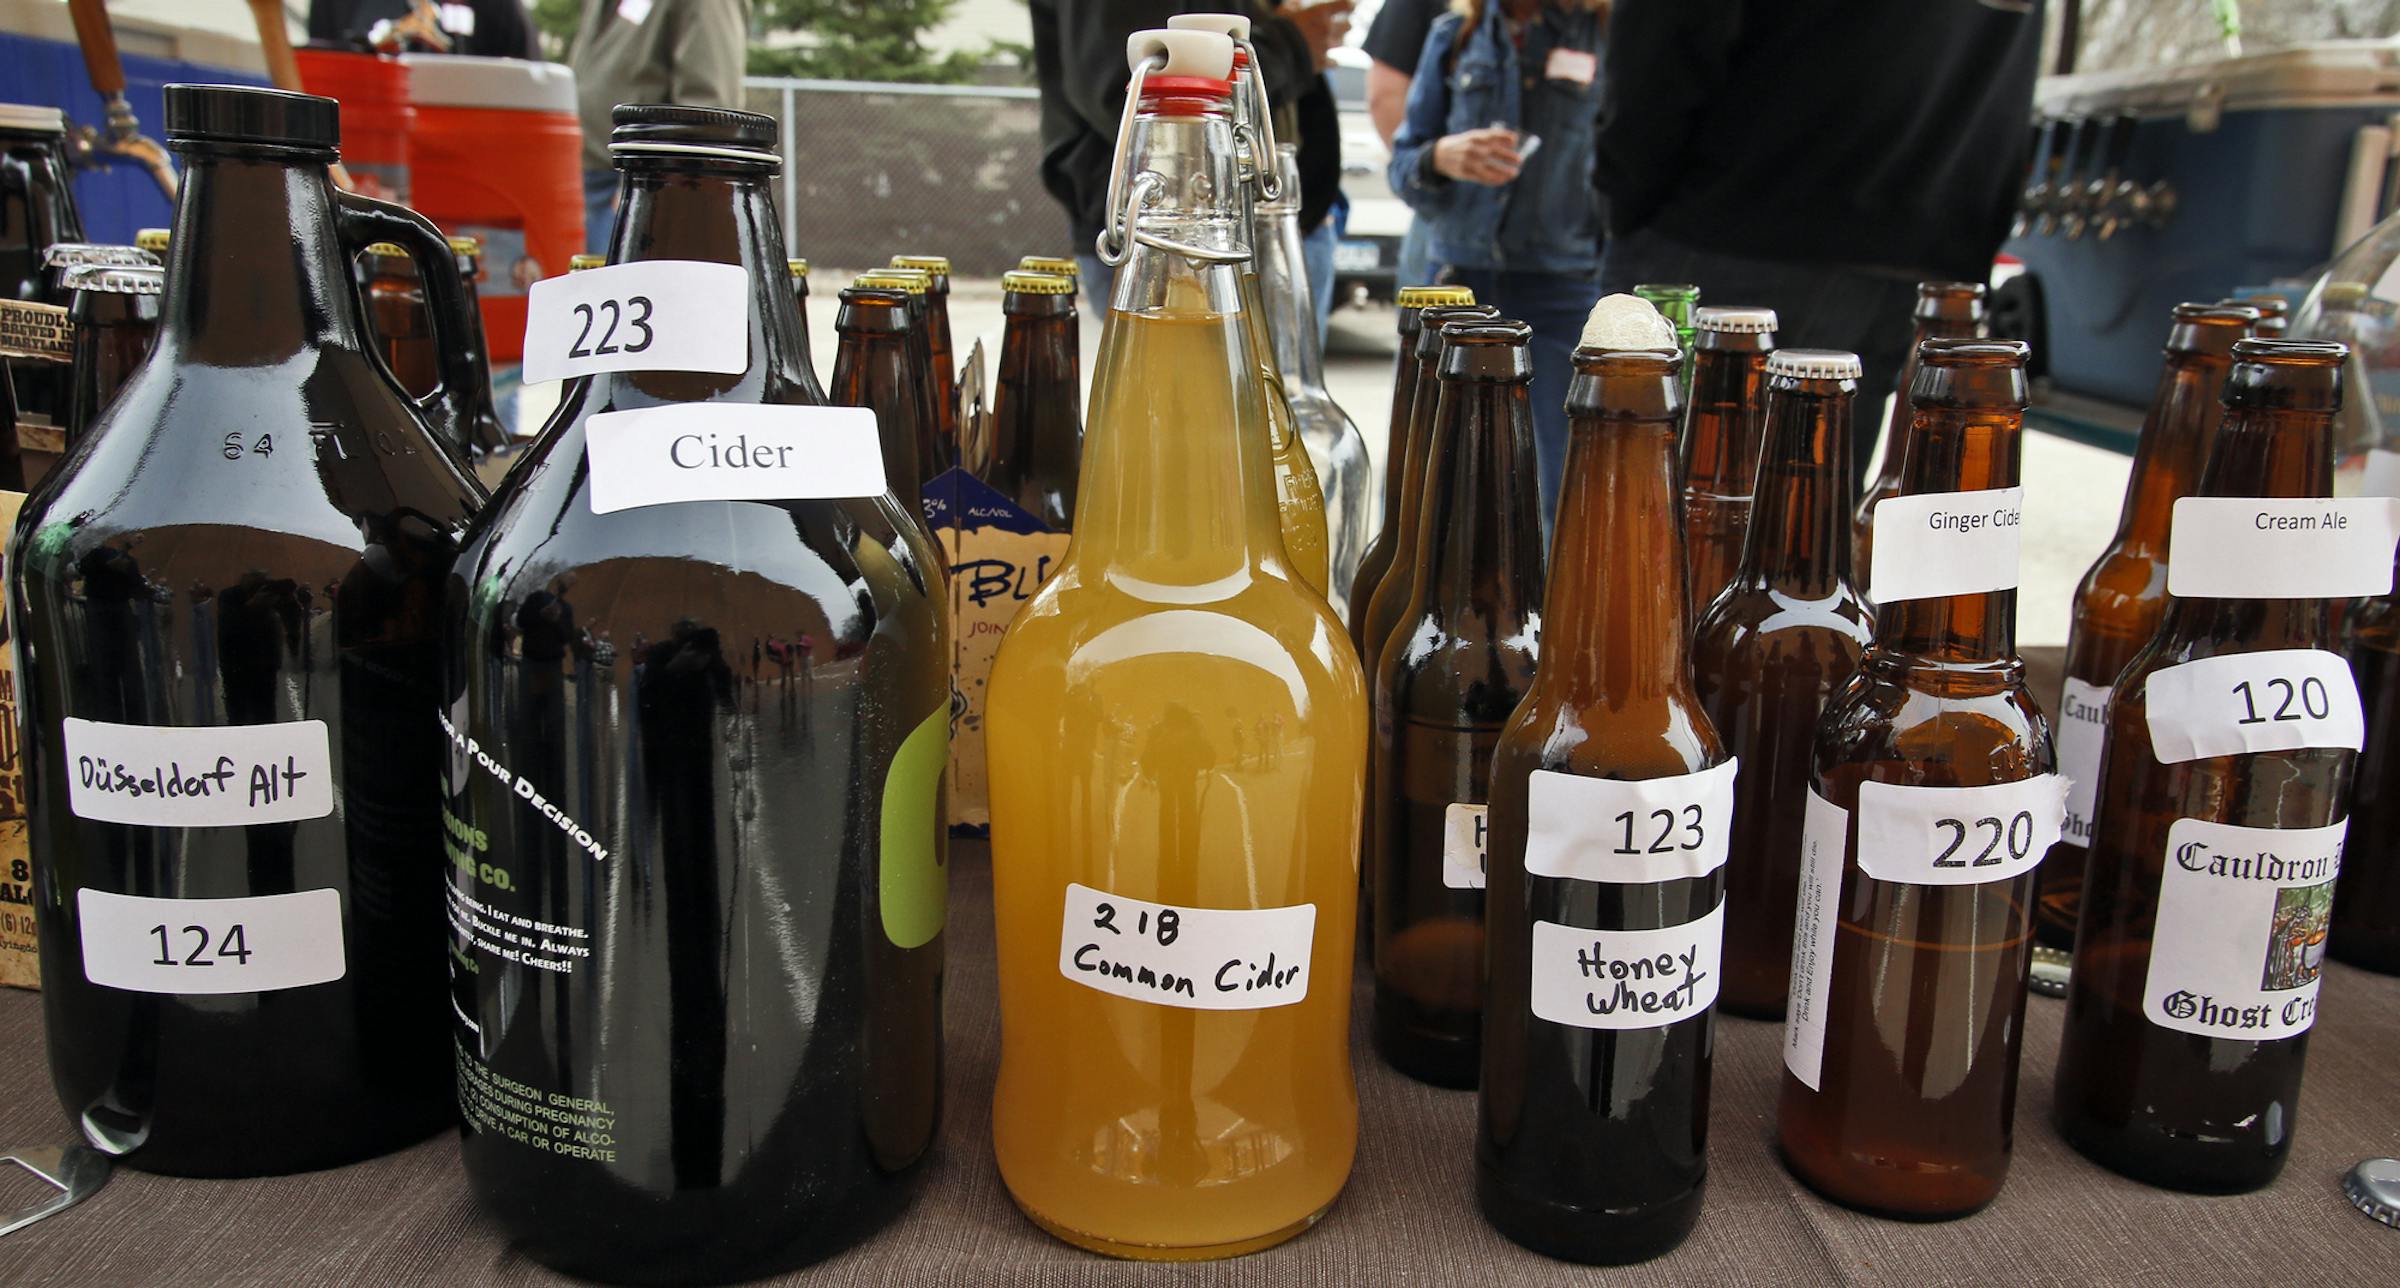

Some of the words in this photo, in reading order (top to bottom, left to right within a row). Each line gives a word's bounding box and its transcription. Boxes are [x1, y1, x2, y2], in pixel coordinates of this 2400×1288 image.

[569, 296, 653, 359] 223
[224, 431, 274, 460] 64
[670, 433, 794, 469] Cider
[1929, 511, 1988, 533] Ginger
[2255, 512, 2316, 530] Cream
[2321, 511, 2347, 529] Ale
[2232, 676, 2329, 725] 120
[249, 755, 308, 808] Alt
[455, 733, 466, 748] A
[466, 737, 513, 785] POUR
[513, 775, 609, 862] DECISION
[1613, 803, 1705, 855] 123
[1932, 810, 2034, 868] 220
[480, 862, 516, 892] CO.
[2176, 841, 2329, 882] Cauldron
[487, 904, 492, 916] I
[493, 909, 510, 923] EAT
[511, 916, 533, 929] AND
[534, 921, 589, 939] BREATHE.
[1094, 902, 1180, 946] 218
[1813, 903, 1821, 923] you
[150, 924, 252, 966] 124
[502, 948, 519, 962] ME!
[504, 931, 518, 944] ME
[521, 936, 536, 948] IN.
[540, 938, 590, 958] ALWAYS
[1810, 923, 1818, 947] while
[1074, 943, 1195, 998] Common
[1215, 951, 1300, 992] Cider
[1577, 941, 1697, 980] Honey
[1806, 951, 1817, 977] Enjoy
[1805, 975, 1813, 996] and
[1801, 997, 1810, 1022] Drink
[2163, 990, 2272, 1030] Ghost
[474, 1060, 489, 1080] THE
[492, 1072, 542, 1102] SURGEON
[548, 1093, 615, 1116] GENERAL,
[480, 1095, 548, 1135] CONSUMPTION
[552, 1126, 570, 1139] OF
[574, 1130, 616, 1147] ALCO-
[494, 1089, 533, 1115] DURING
[535, 1105, 615, 1131] PREGNANCY
[498, 1122, 506, 1135] A
[507, 1126, 529, 1145] CAR
[532, 1136, 551, 1151] OR
[554, 1142, 616, 1163] OPERATE
